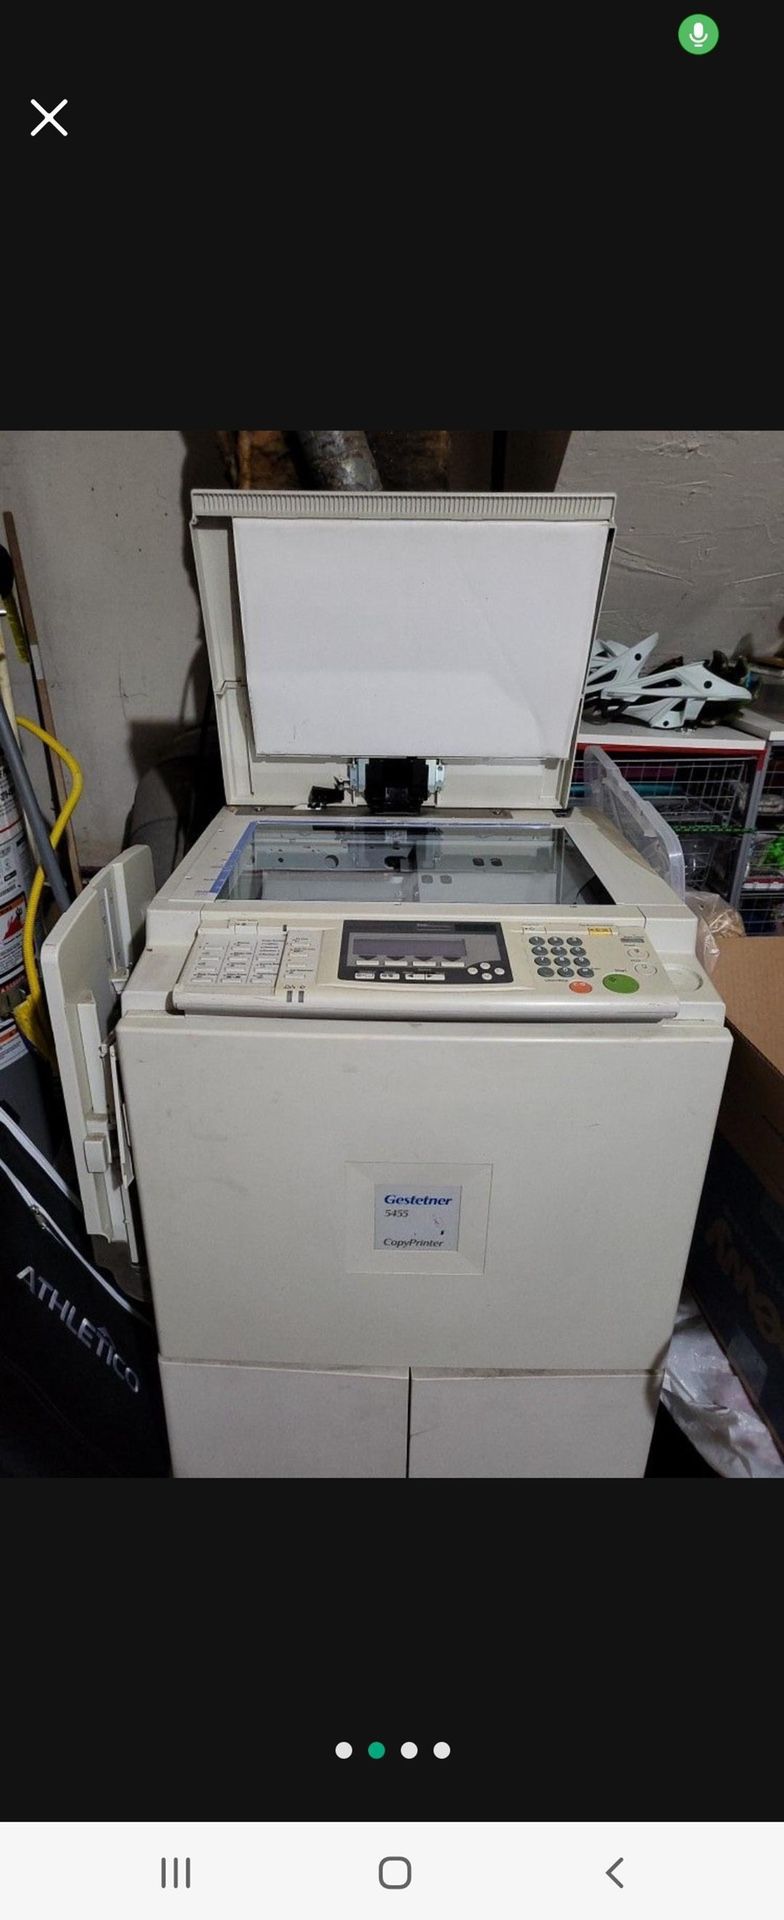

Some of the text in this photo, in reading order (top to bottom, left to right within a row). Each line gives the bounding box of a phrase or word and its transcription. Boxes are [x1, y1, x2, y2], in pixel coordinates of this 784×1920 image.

[383, 1194, 453, 1206] Gestetner
[384, 1209, 409, 1218] 5455
[383, 1238, 444, 1249] CopyPrinter
[16, 1265, 140, 1393] ATHLETICO
